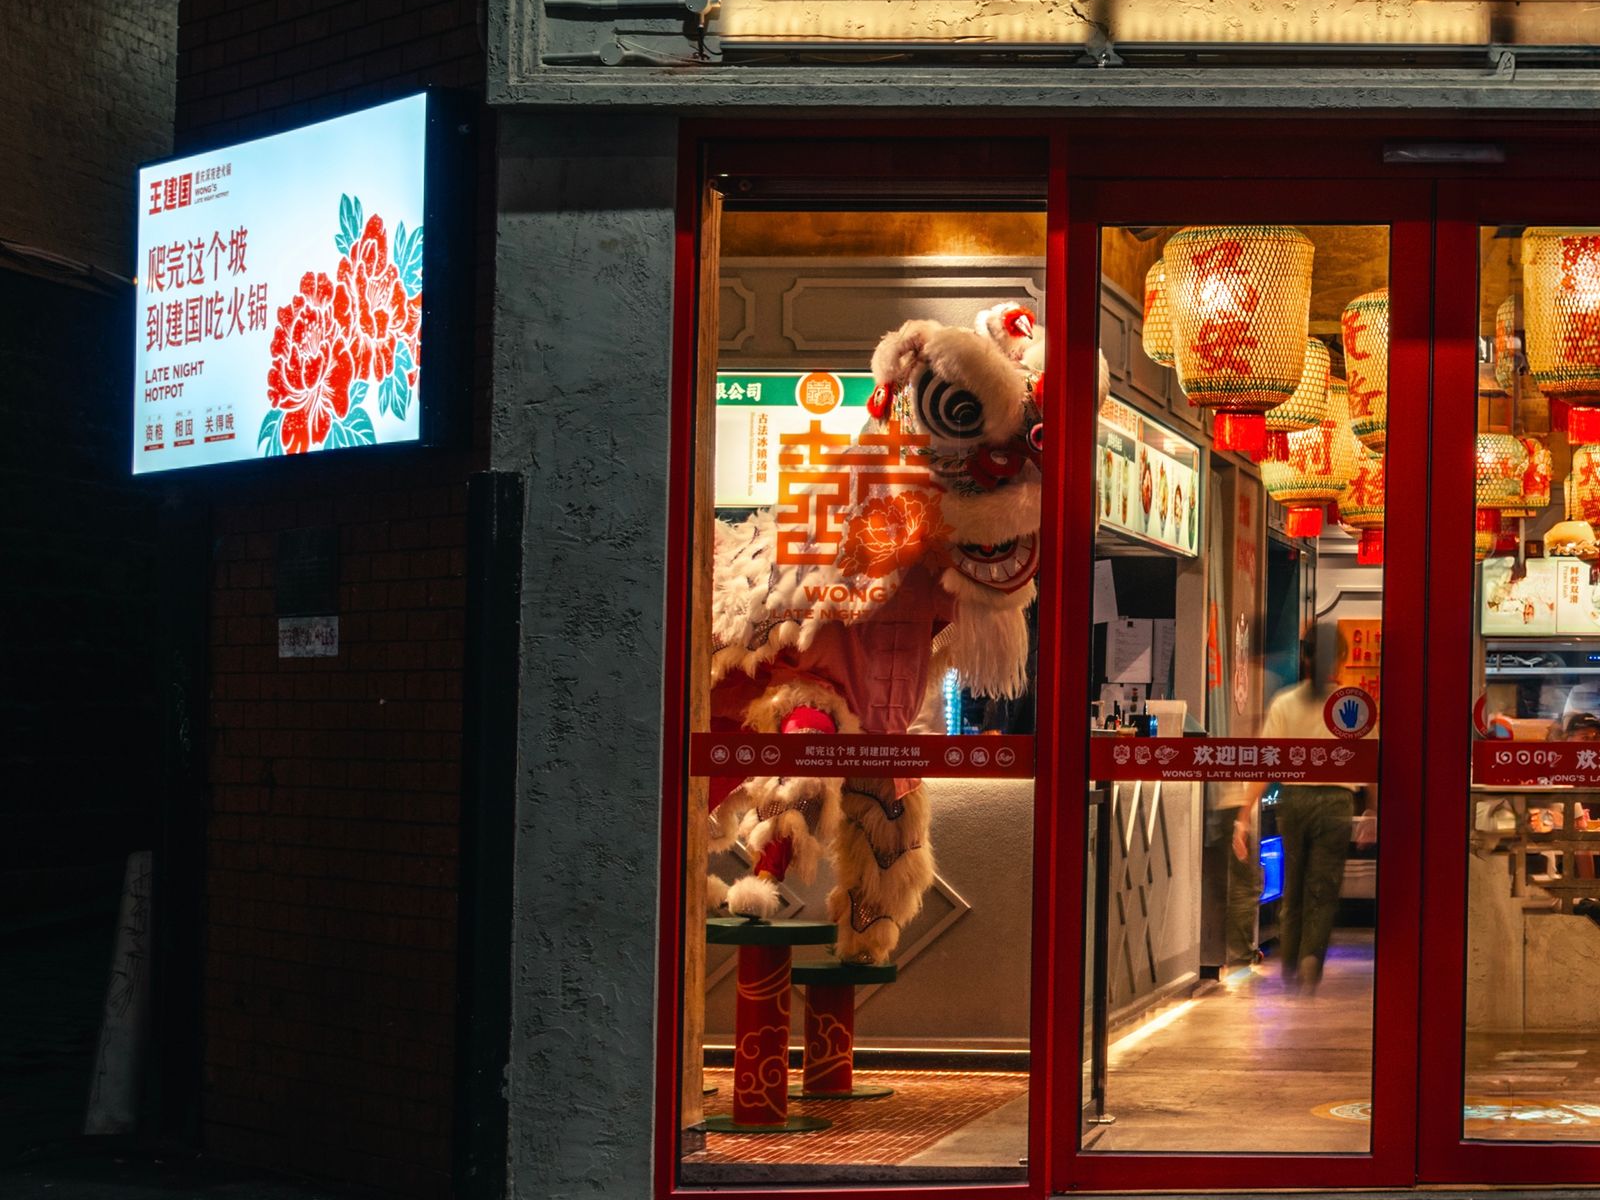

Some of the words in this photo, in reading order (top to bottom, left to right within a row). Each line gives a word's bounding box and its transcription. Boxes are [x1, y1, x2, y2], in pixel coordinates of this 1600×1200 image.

[149, 173, 192, 215] 王建国
[146, 225, 248, 294] 爬完这个坡
[146, 283, 267, 352] 到建国吃火锅
[145, 366, 169, 384] LATE
[173, 360, 204, 379] NIGHT
[145, 383, 184, 402] HOTPOT
[804, 584, 918, 603] WONG'
[772, 609, 814, 620] LATE
[859, 746, 921, 757] 到建国吃火锅
[1192, 746, 1281, 766] 欢迎回家
[863, 759, 890, 767] NIGHT
[1162, 771, 1202, 779] WONG'S
[1234, 771, 1264, 779] NIGHT
[1267, 771, 1305, 779] HOTPOT
